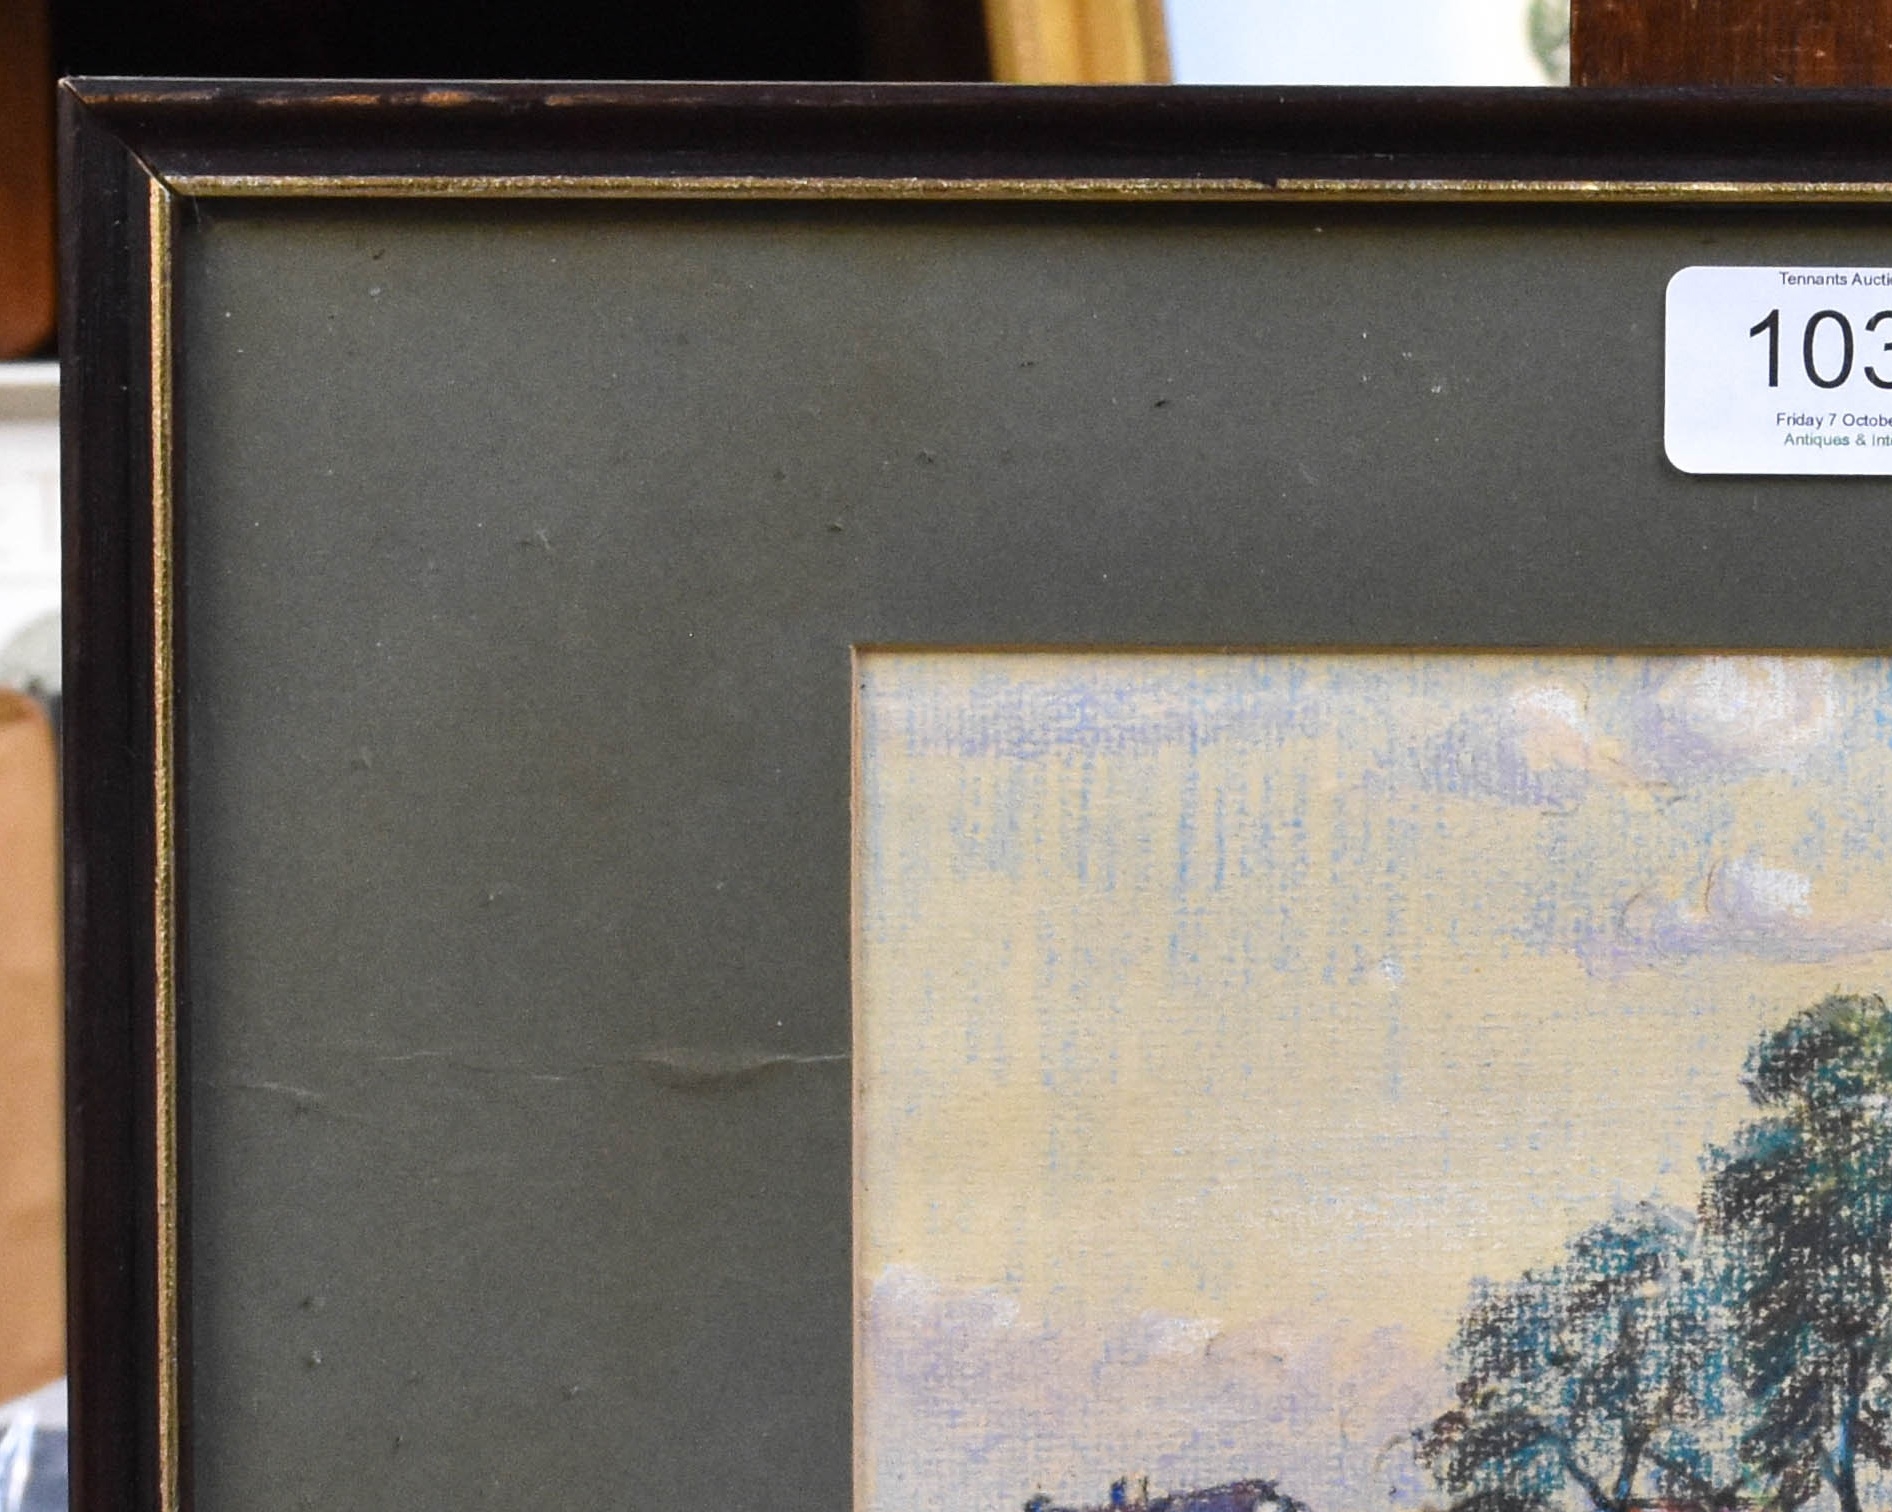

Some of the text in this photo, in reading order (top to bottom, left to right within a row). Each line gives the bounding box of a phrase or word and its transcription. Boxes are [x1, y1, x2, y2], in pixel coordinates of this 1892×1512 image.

[1780, 271, 1848, 287] Tennants
[1776, 413, 1823, 430] Friday
[1828, 413, 1837, 427] 7
[1784, 433, 1850, 448] Antiques
[1855, 434, 1867, 447] &
